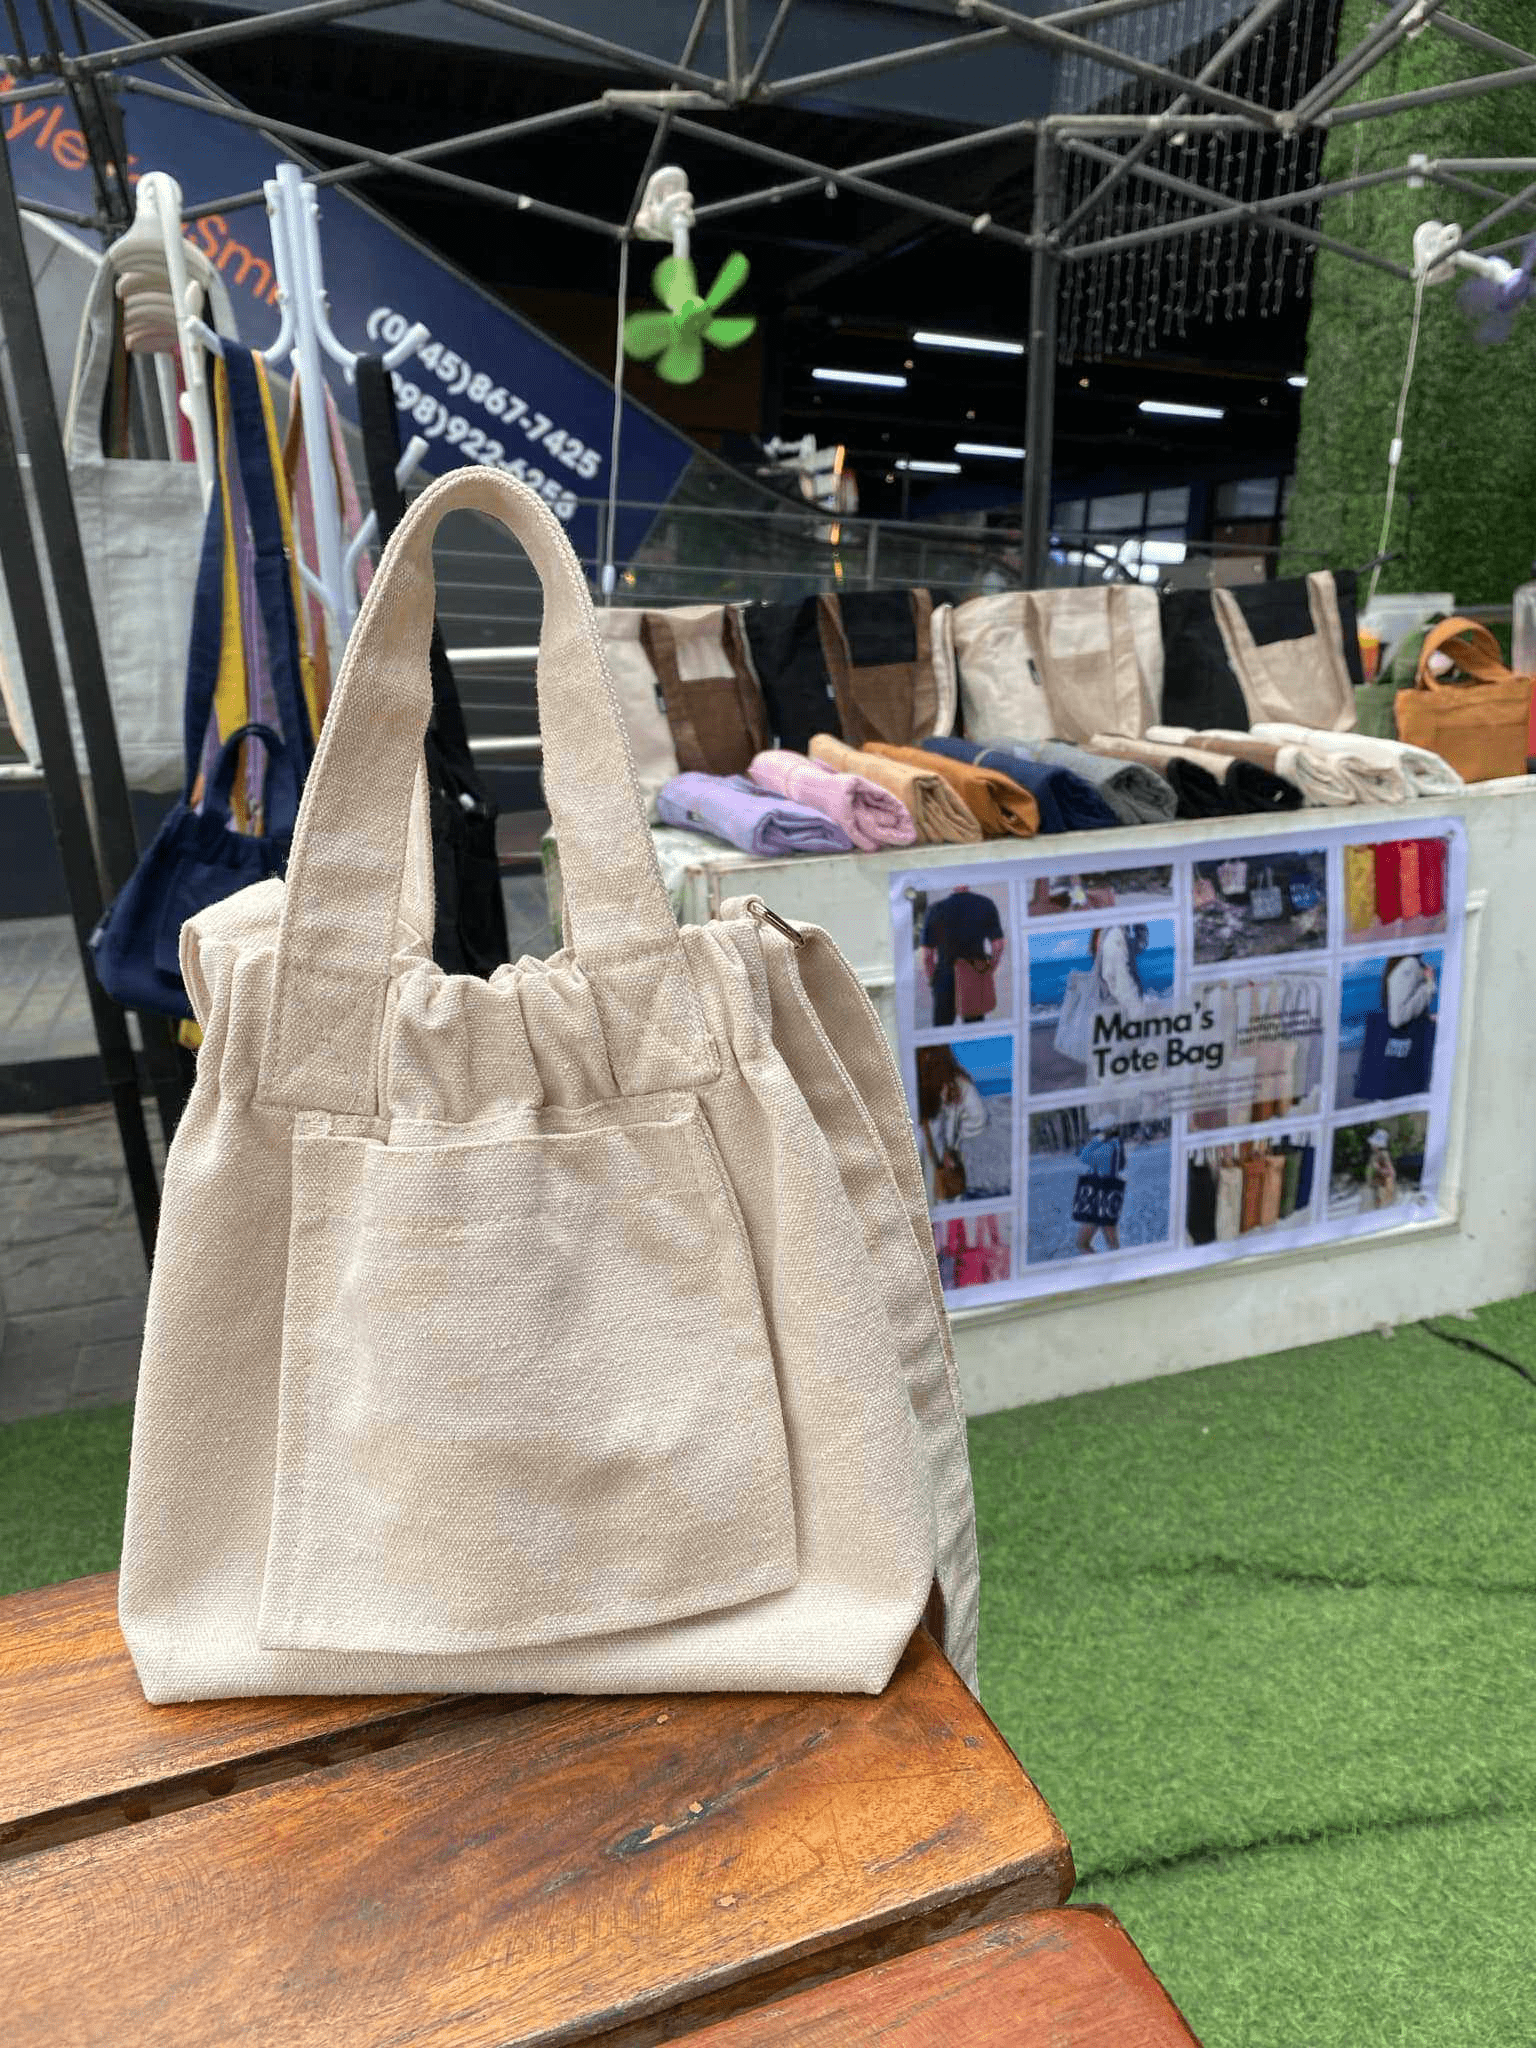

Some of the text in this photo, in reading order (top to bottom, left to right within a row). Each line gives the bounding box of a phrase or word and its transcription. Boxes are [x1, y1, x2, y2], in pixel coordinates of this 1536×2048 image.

[366, 307, 602, 479] (045)867-7425
[1093, 1002, 1214, 1045] Mama's
[1093, 1038, 1224, 1077] Tote Bag
